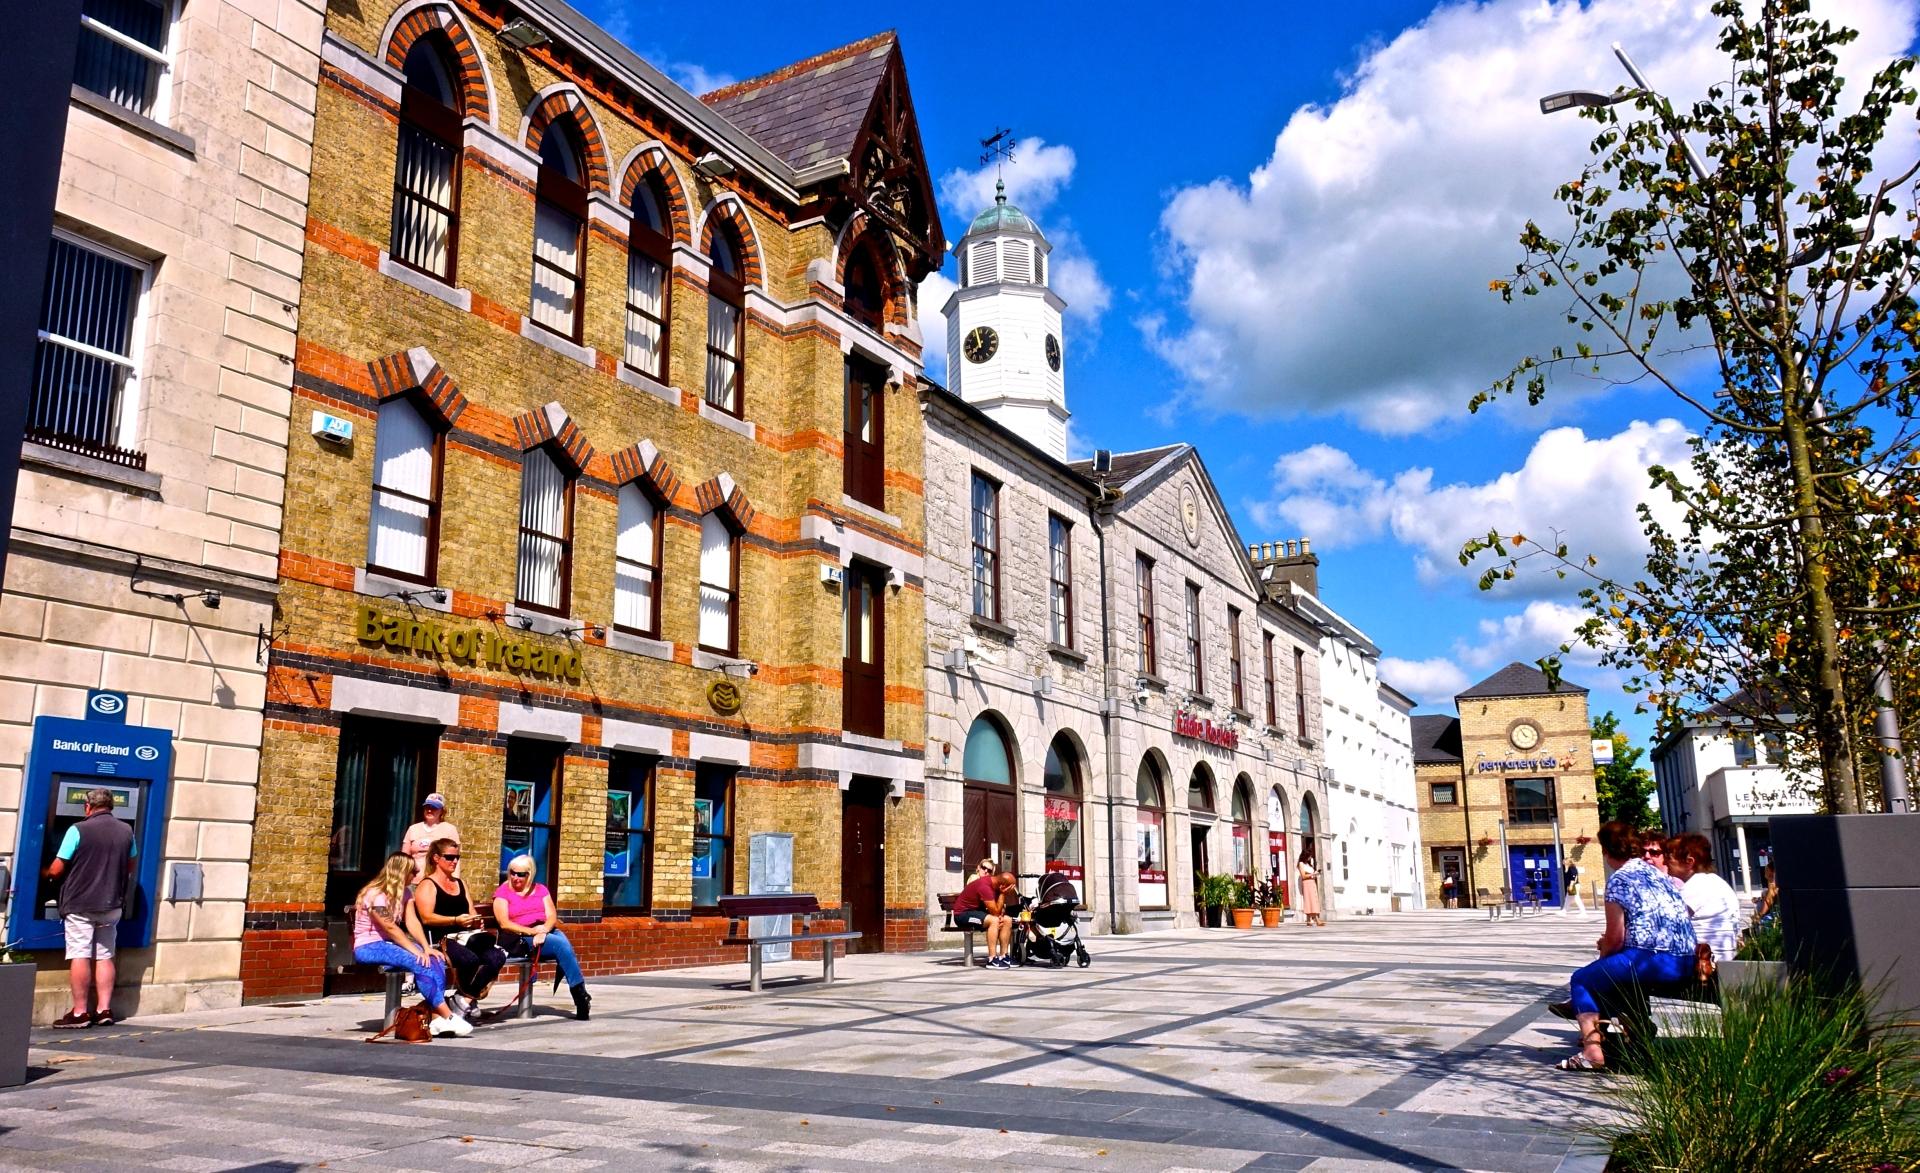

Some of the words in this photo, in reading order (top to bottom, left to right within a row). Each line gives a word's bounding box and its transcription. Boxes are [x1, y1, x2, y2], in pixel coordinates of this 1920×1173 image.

[1009, 139, 1016, 150] S
[981, 152, 988, 165] N
[1009, 151, 1017, 164] E
[358, 605, 445, 654] Bank
[449, 628, 484, 661] of
[486, 631, 582, 678] Ireland
[53, 739, 81, 752] Bank
[82, 743, 94, 753] of
[94, 743, 130, 756] Ireland
[1479, 758, 1538, 772] permanent
[1539, 757, 1557, 769] tsb
